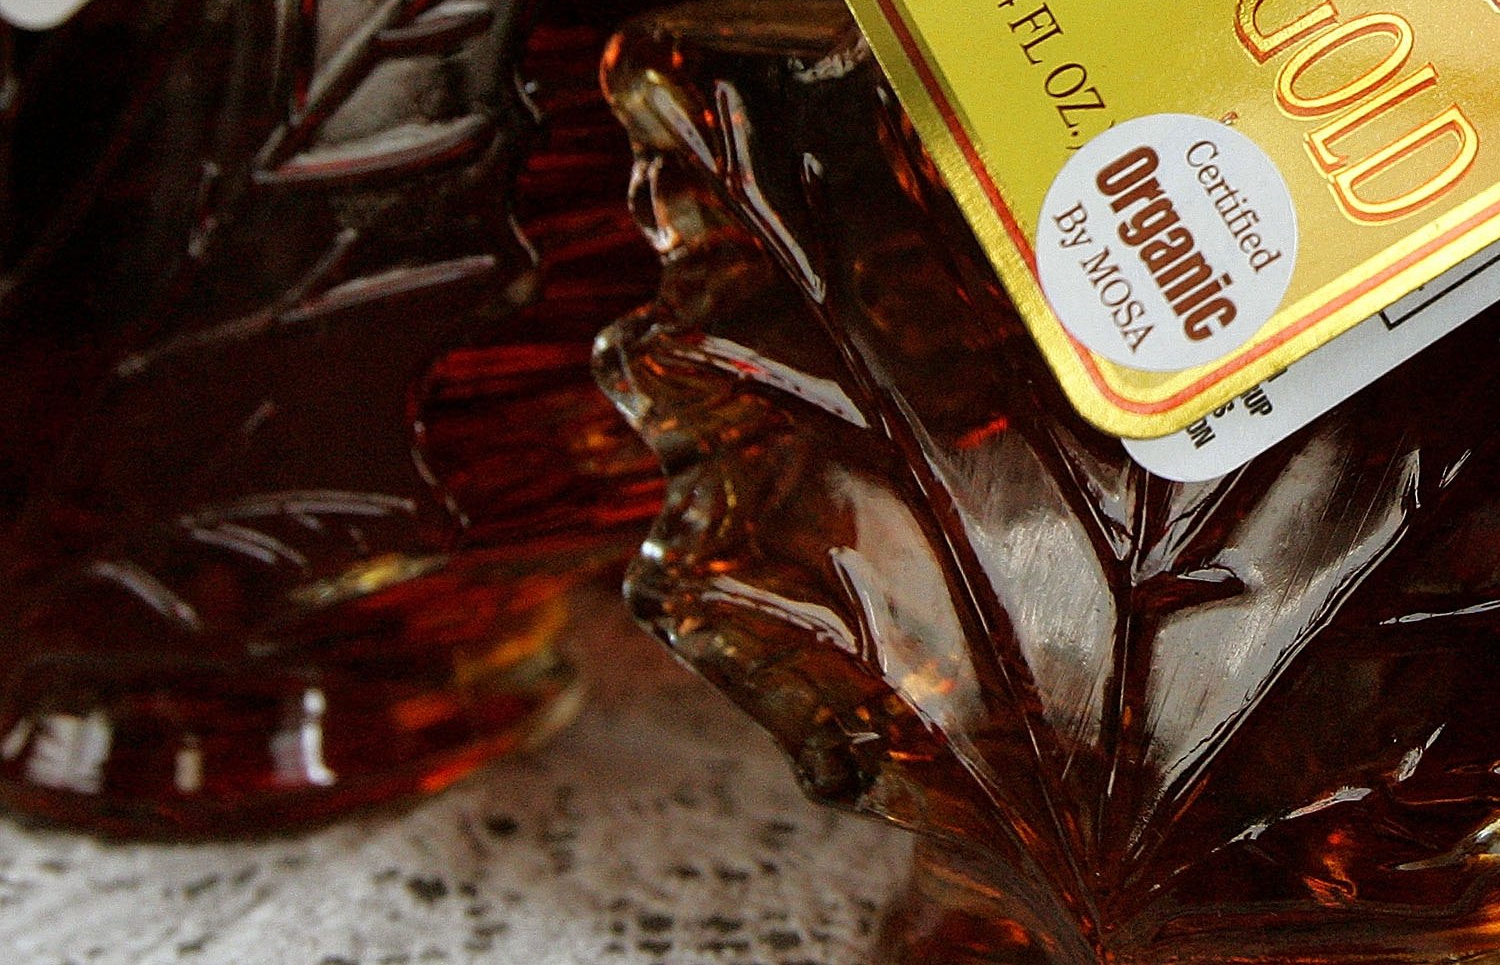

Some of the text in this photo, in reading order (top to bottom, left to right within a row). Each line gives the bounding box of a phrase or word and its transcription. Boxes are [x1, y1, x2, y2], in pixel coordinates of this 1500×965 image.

[1007, 2, 1063, 65] FL
[1054, 200, 1155, 354] By MOSA
[1096, 145, 1237, 341] Organic
[1186, 140, 1281, 273] Certified
